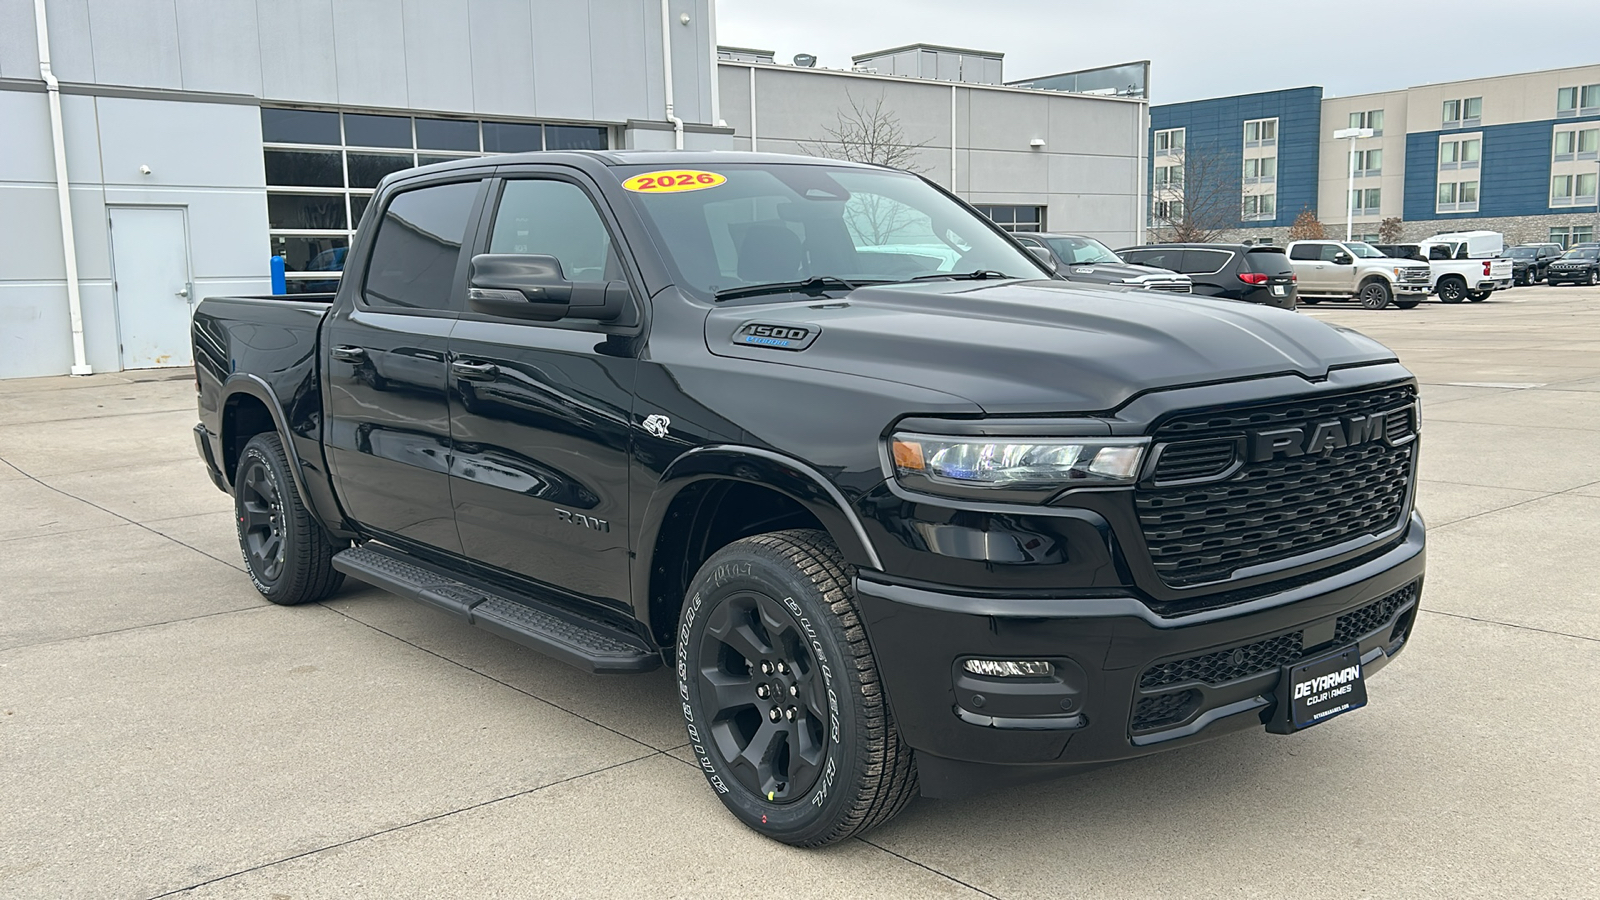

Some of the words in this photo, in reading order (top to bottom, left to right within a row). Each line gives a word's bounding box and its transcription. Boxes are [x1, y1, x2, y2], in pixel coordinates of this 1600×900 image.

[637, 174, 715, 190] 2026
[748, 326, 805, 339] 1500
[1255, 411, 1386, 462] RAM
[554, 507, 610, 533] RAM
[678, 592, 730, 794] BRIDGESTONE
[1294, 665, 1360, 699] DEYARMAN
